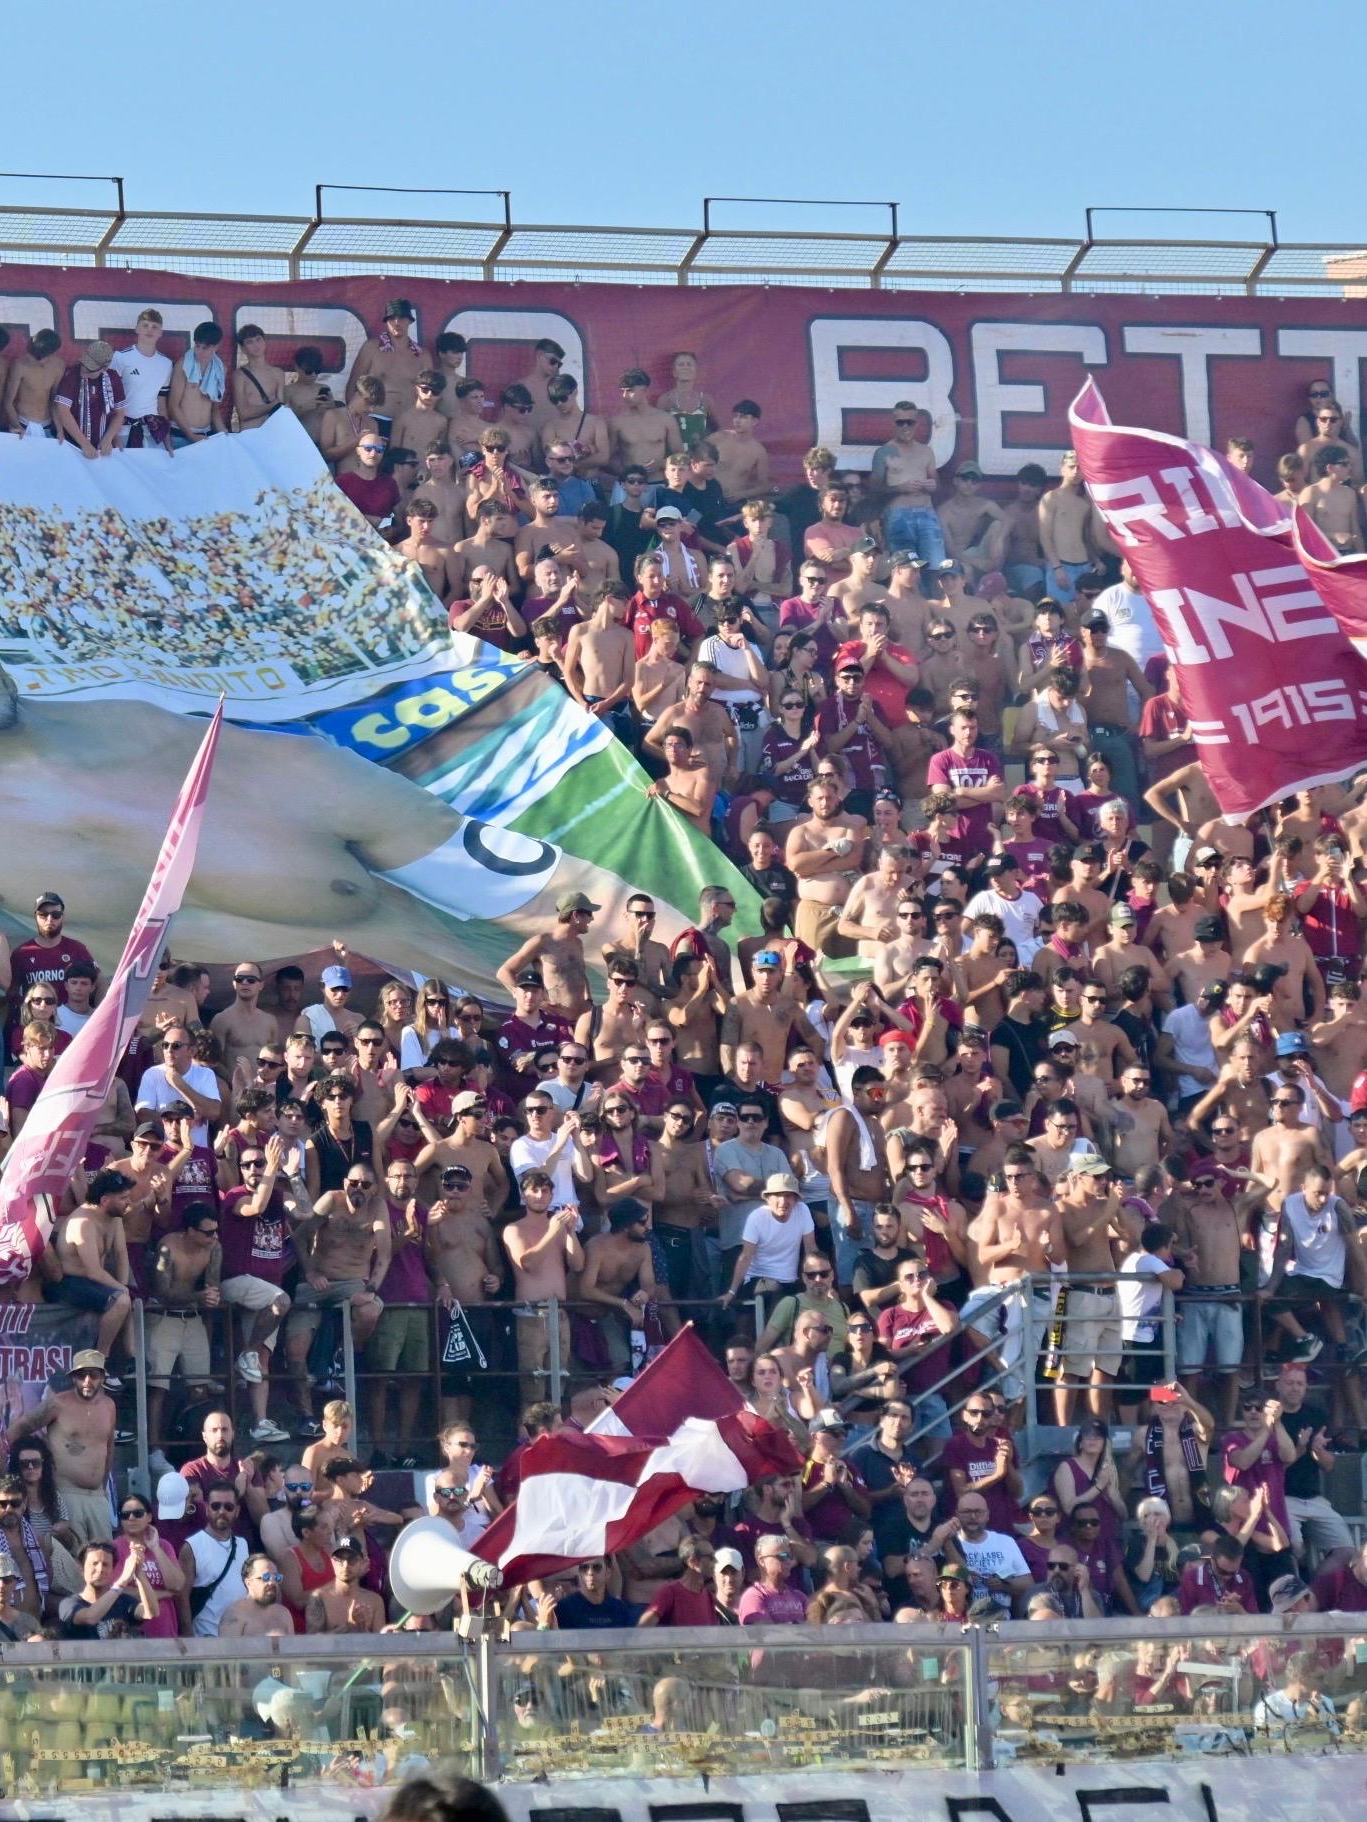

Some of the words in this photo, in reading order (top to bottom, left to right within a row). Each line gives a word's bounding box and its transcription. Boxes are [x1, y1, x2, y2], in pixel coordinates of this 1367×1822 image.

[810, 318, 1367, 478] BETT
[1150, 565, 1339, 665] INE
[350, 650, 530, 750] cas
[1231, 679, 1356, 745] 1915
[980, 1551, 1005, 1560] LABEL
